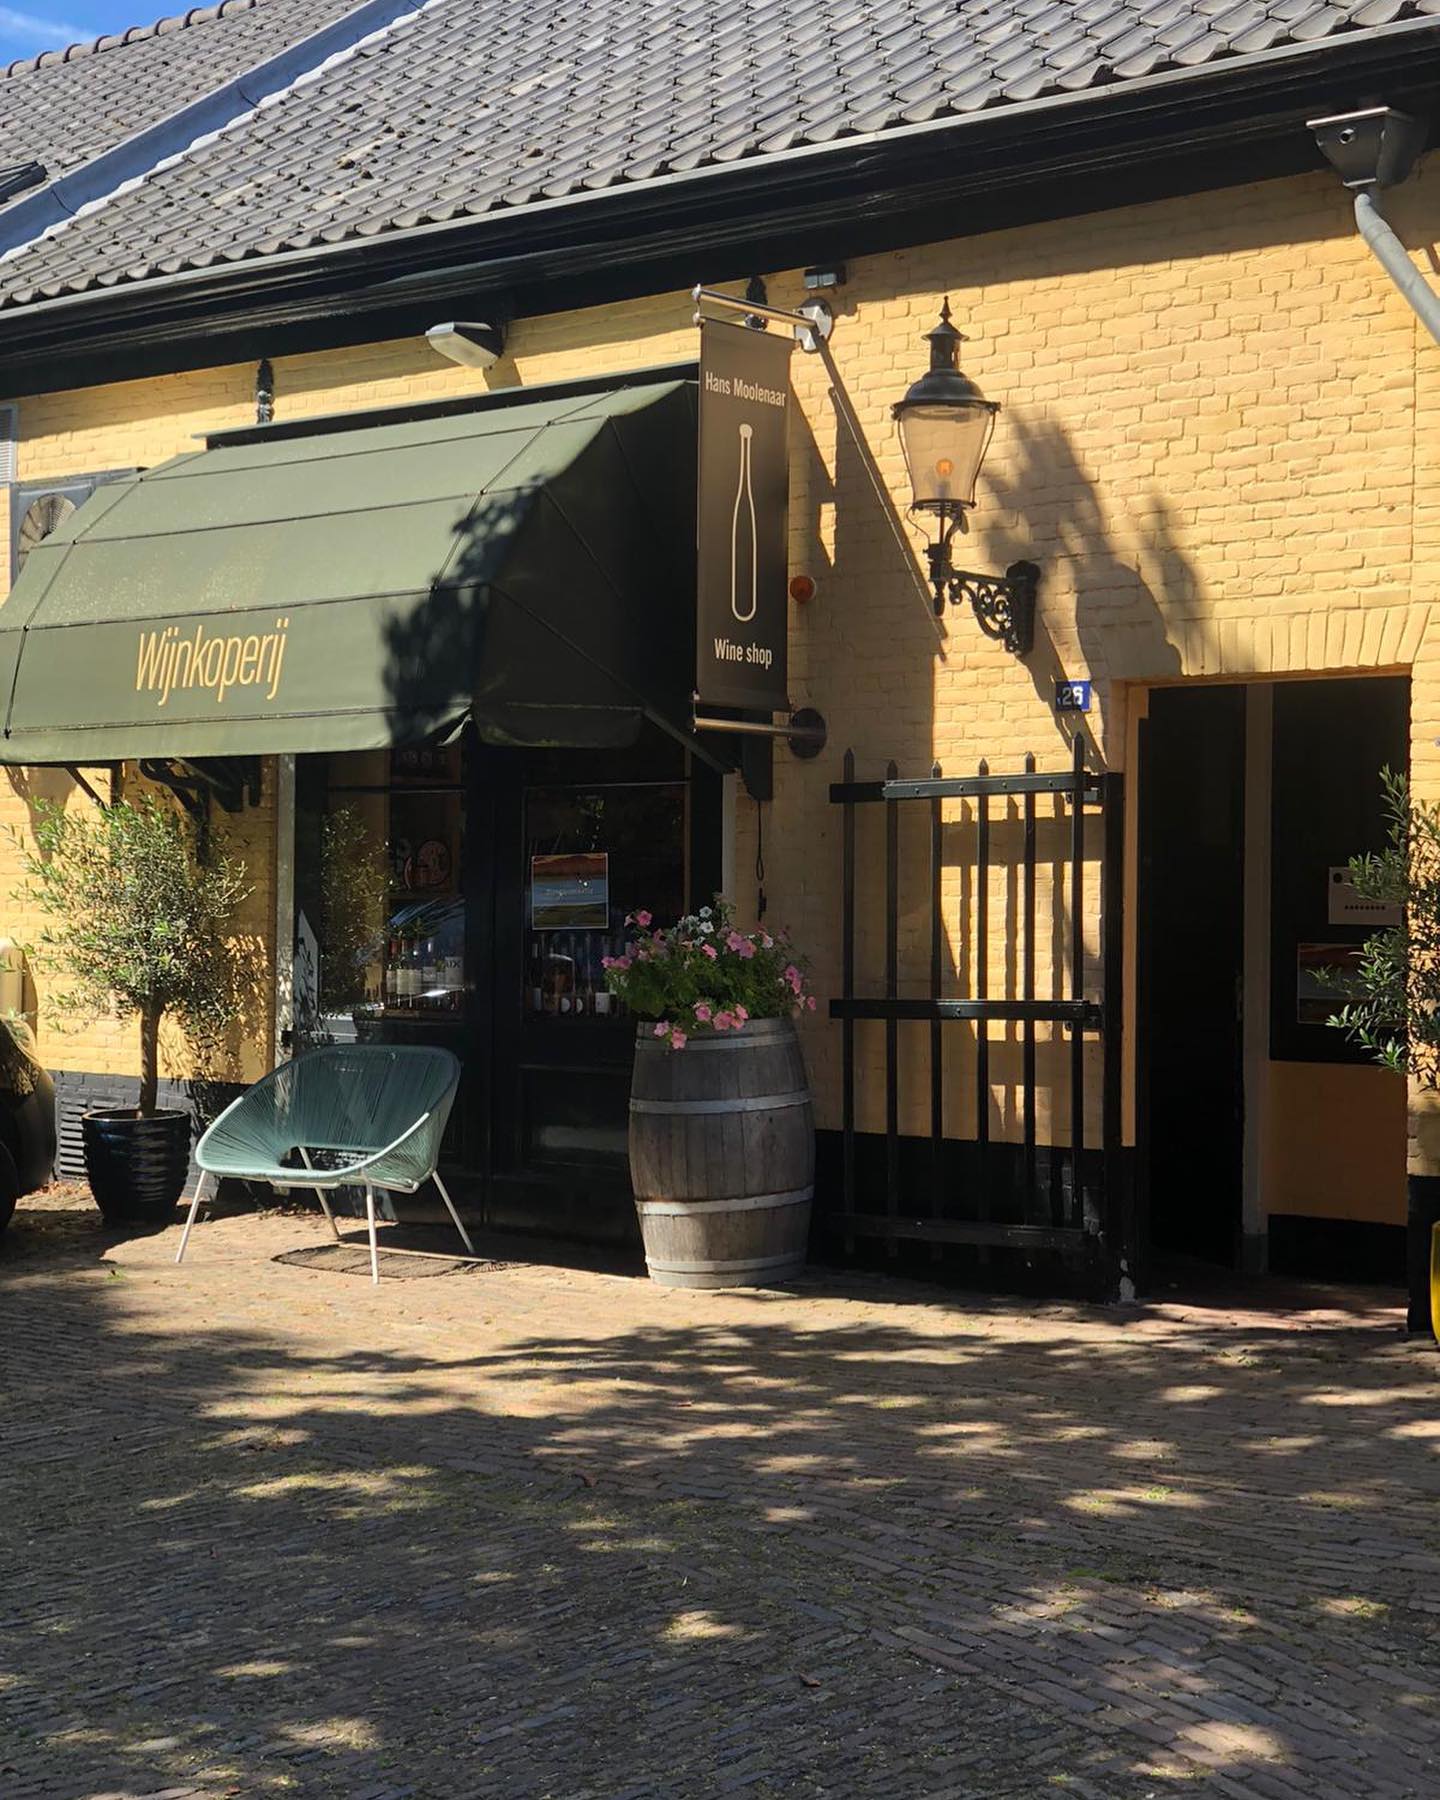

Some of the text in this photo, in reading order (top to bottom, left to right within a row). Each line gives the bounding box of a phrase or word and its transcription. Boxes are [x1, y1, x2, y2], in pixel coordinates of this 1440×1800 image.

[705, 371, 786, 407] Hans Moolenaar
[136, 617, 289, 706] Wijnkoperij
[714, 638, 772, 670] Wine shop
